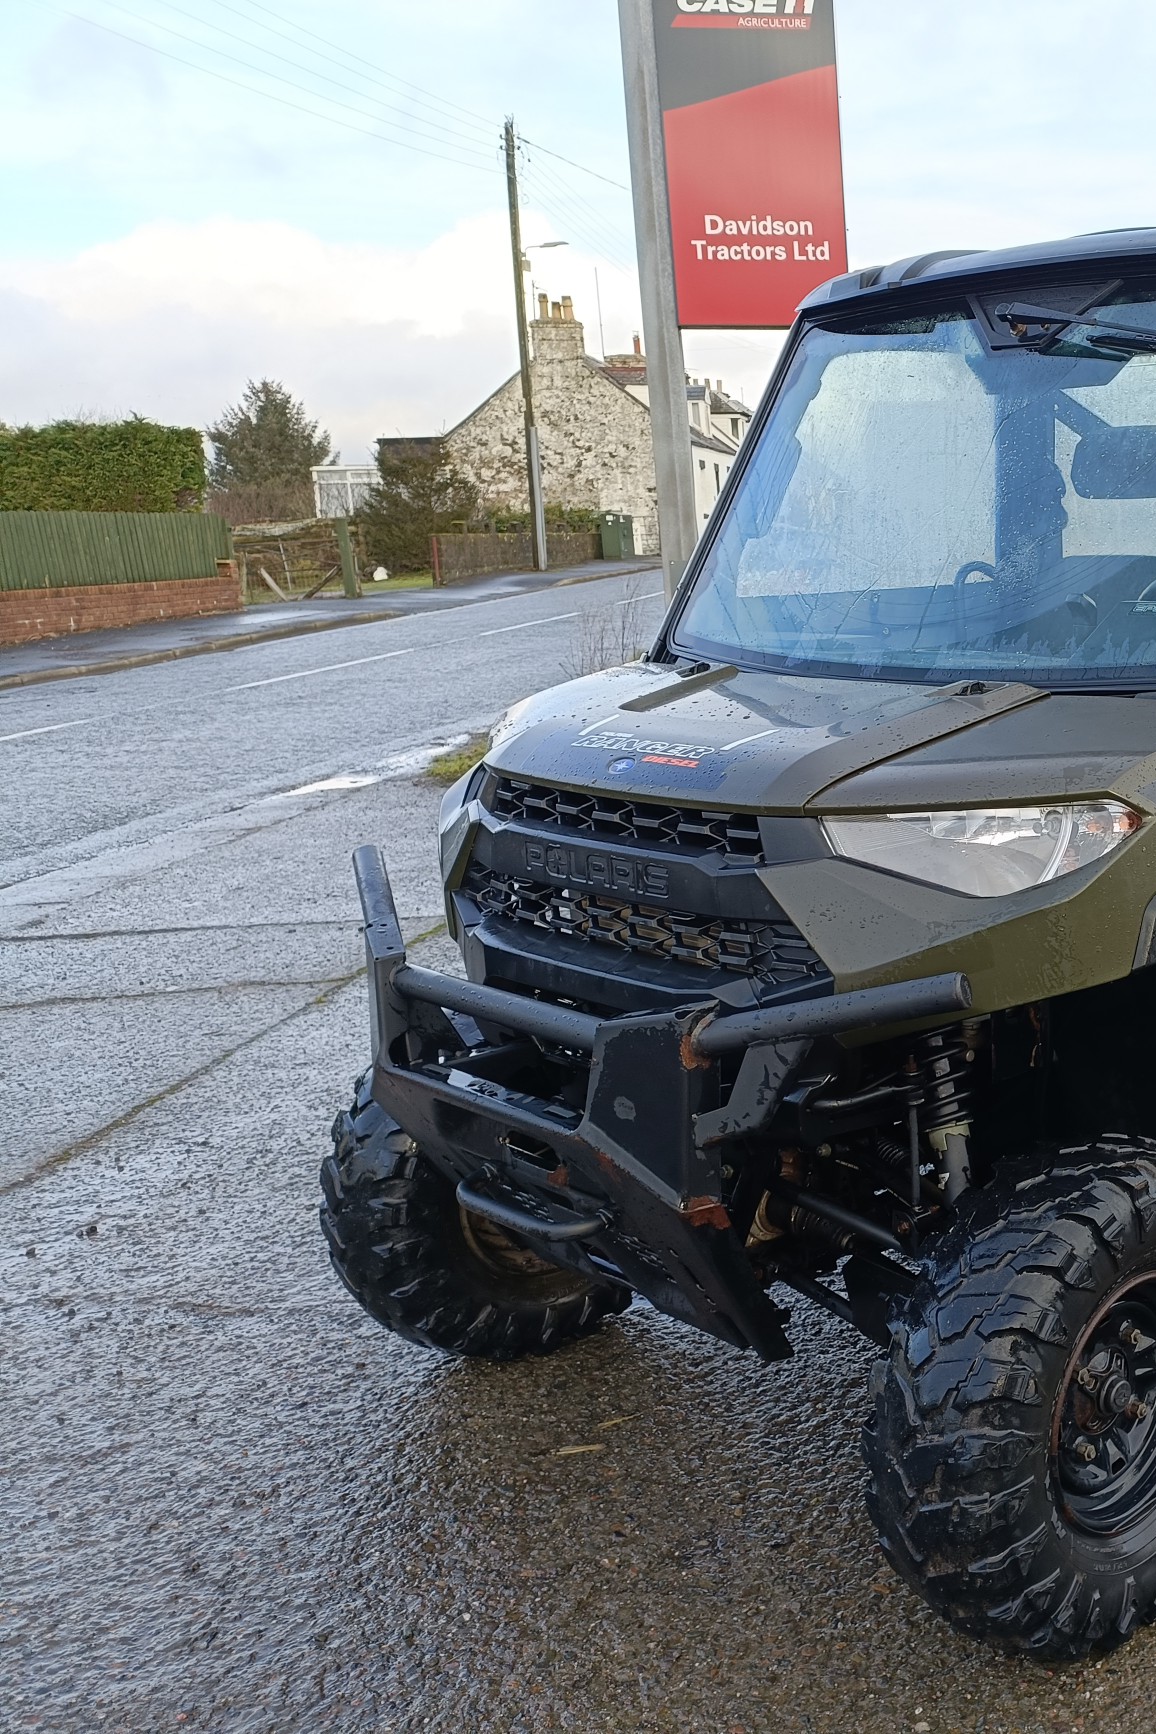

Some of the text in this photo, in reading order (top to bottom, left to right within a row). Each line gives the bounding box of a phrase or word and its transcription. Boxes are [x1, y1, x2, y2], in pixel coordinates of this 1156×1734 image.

[676, 0, 777, 13] CASE
[738, 17, 807, 28] AGRICULTURE
[704, 214, 813, 236] Davidson
[691, 240, 830, 261] Tractors Ltd
[571, 735, 716, 759] RANGER
[641, 755, 700, 769] DIESEL
[525, 840, 670, 899] POLARIS
